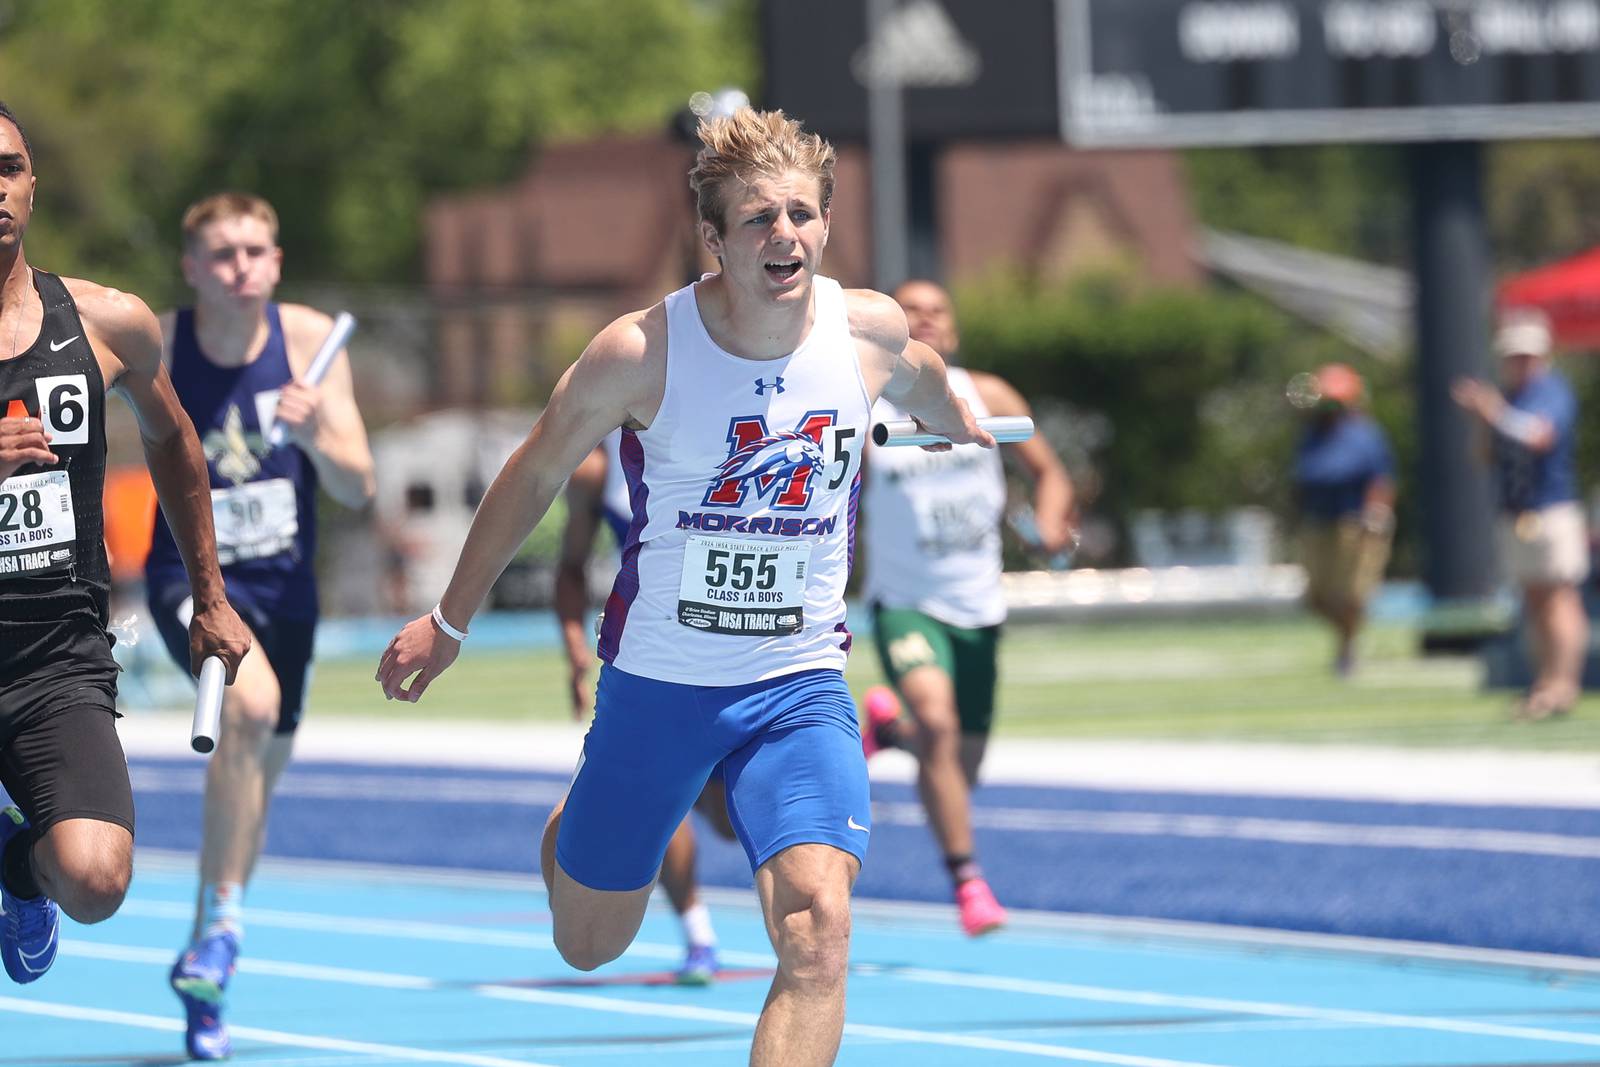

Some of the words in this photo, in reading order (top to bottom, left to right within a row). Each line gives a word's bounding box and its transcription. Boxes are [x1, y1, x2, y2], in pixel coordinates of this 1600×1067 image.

[48, 384, 84, 433] 6
[828, 428, 856, 490] 5
[0, 489, 44, 532] 28
[675, 510, 838, 537] MORRISON
[14, 532, 27, 544] 1A
[29, 527, 53, 542] BOYS
[19, 550, 51, 571] TRACK
[705, 549, 779, 590] 555
[707, 588, 740, 603] CLASS
[744, 591, 755, 603] 1A
[758, 591, 783, 603] BOYS
[718, 611, 743, 630] IHSA
[743, 613, 777, 630] TRACK
